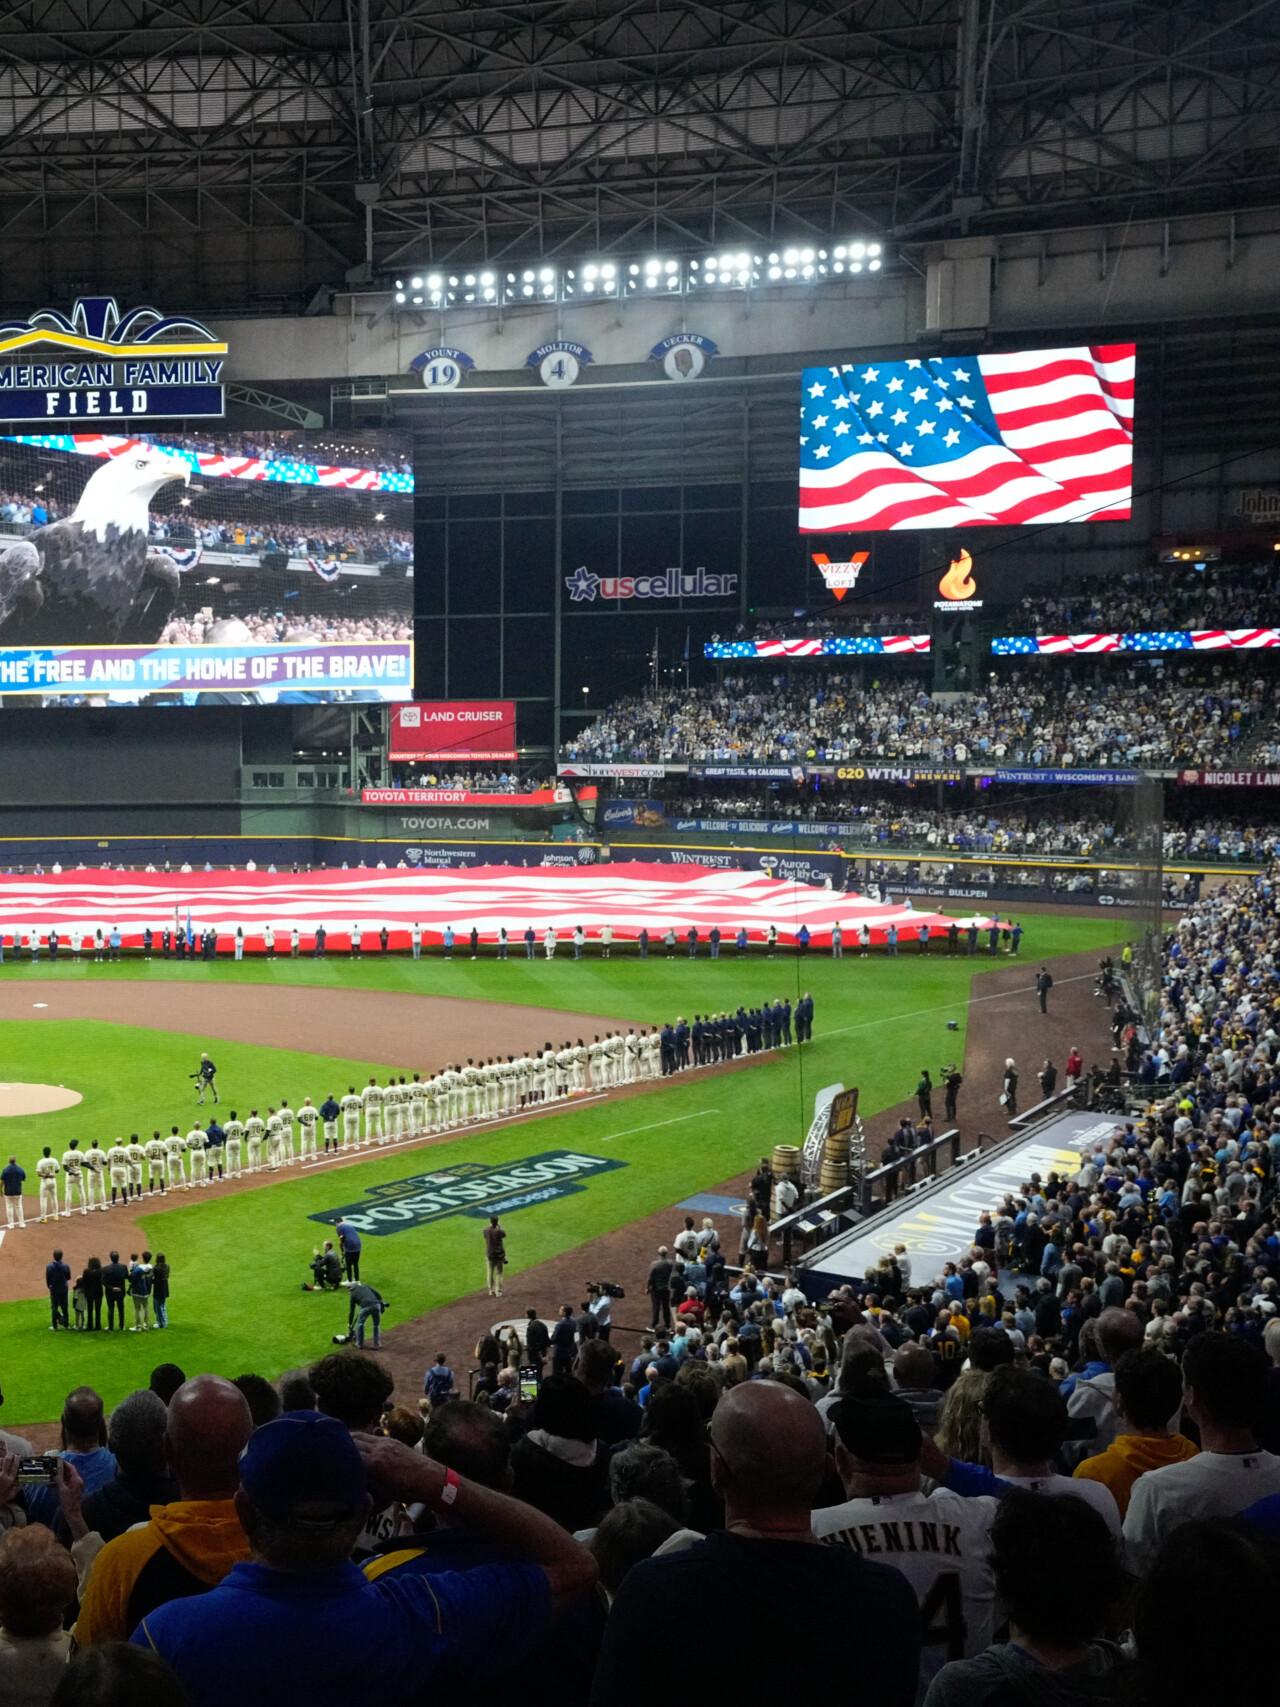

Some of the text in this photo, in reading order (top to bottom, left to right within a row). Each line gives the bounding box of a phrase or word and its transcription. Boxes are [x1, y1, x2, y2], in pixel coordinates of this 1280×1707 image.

[662, 335, 704, 348] UECKER
[424, 349, 460, 360] YOUNT
[536, 342, 583, 357] MOLITOR
[124, 361, 224, 385] FAMILY
[428, 364, 456, 386] 19
[552, 359, 565, 379] 4
[46, 390, 148, 415] FIELD
[819, 563, 862, 575] VIZZY
[601, 567, 737, 599] uscellular
[34, 659, 87, 683] FREE
[91, 658, 135, 681] AND
[139, 658, 181, 681] THE
[186, 657, 247, 680] HOME
[251, 656, 278, 679] OF
[283, 656, 325, 679] THE
[329, 655, 406, 678] BRAVE!
[424, 711, 503, 722] LAND CRUISER
[705, 768, 725, 776] GREAT
[748, 768, 756, 776] 96
[757, 768, 791, 777] CALORIES.
[837, 767, 911, 780] 620 WTMJ
[997, 770, 1114, 782] WINTRUST WISCONSIN'S
[1204, 773, 1252, 785] NICOLET
[365, 791, 467, 802] TOYOTA TERRITORY
[401, 817, 489, 830] TOYOTA.COM
[700, 822, 728, 831] WELCOME
[739, 822, 768, 832] DELICIOUS
[798, 824, 828, 834] WELCOME
[424, 849, 476, 859] Northwestern
[544, 853, 574, 863] Johnson
[424, 856, 451, 865] Mutual
[779, 859, 810, 869] Aurora
[905, 887, 988, 898] Health Care BULLPEN
[343, 1154, 608, 1231] POSTSEASON
[687, 1240, 694, 1251] 8
[937, 1341, 956, 1360] 10
